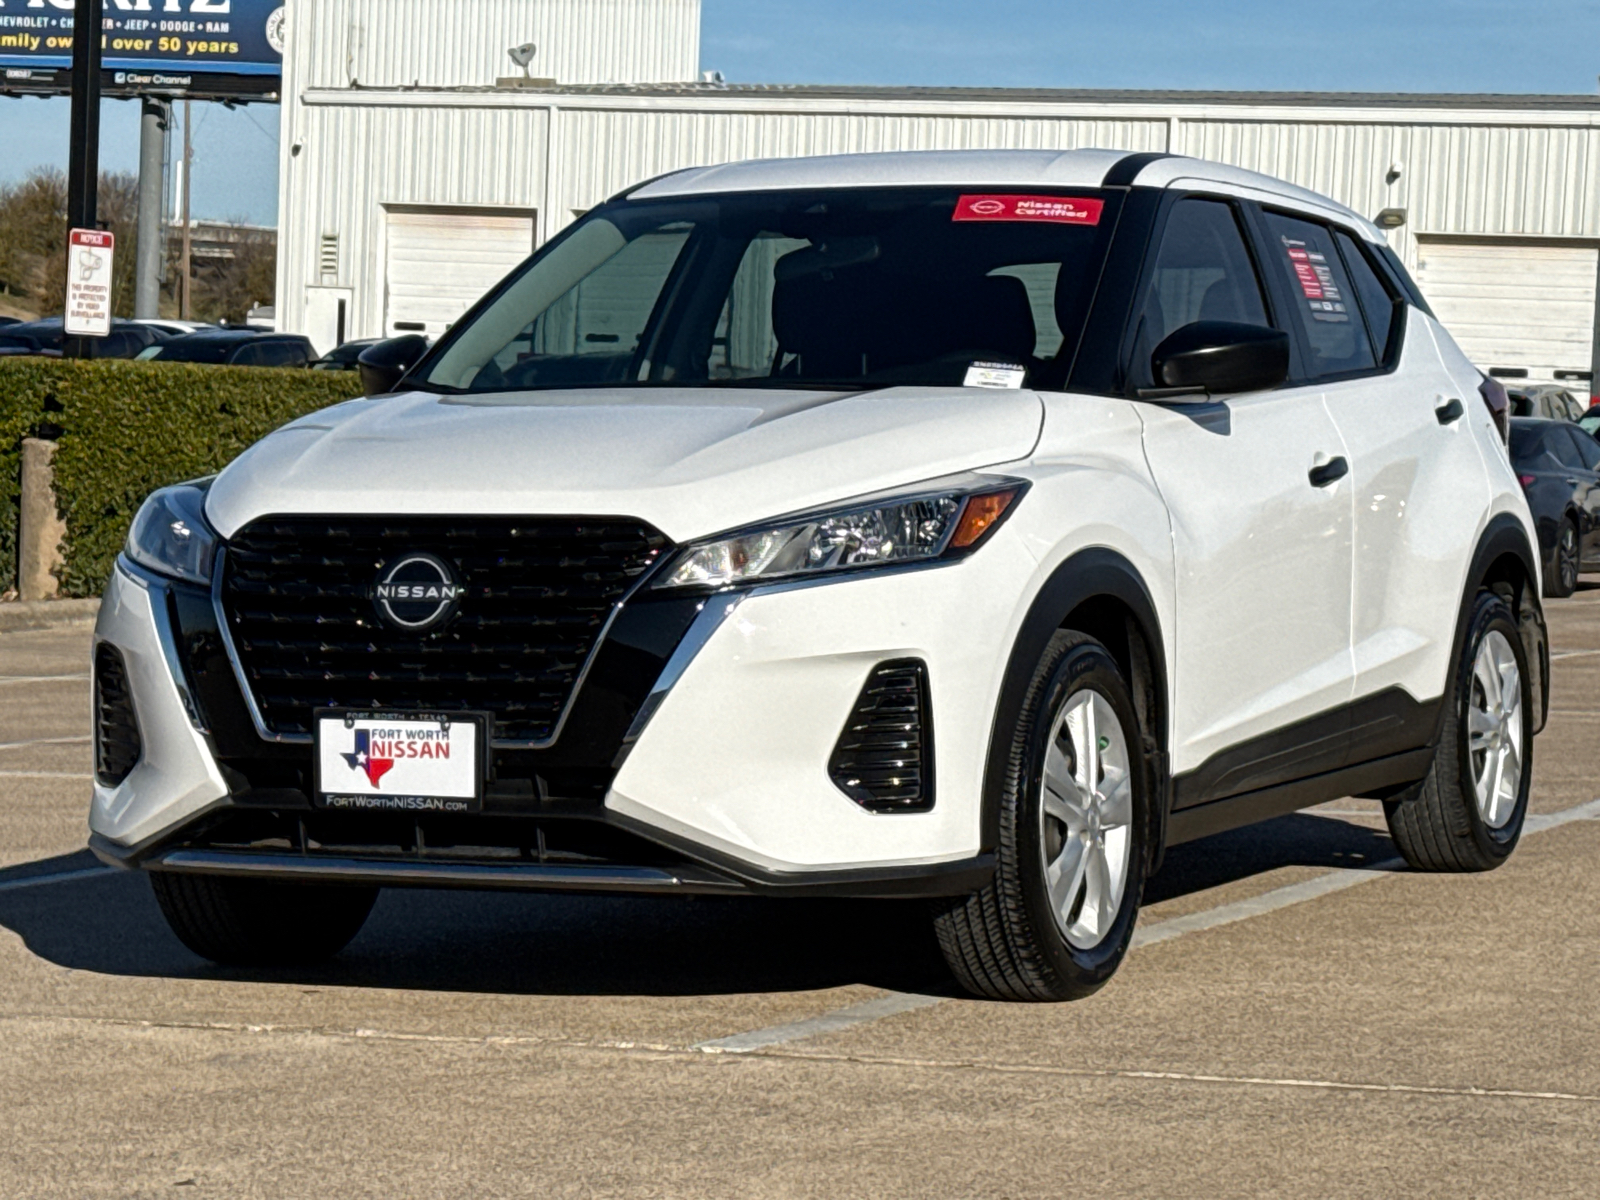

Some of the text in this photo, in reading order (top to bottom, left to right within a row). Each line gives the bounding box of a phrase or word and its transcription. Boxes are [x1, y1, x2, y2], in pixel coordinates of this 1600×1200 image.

[124, 19, 150, 31] JEEP
[160, 20, 195, 32] DODGE
[205, 22, 230, 33] RAM
[112, 38, 153, 51] over
[158, 37, 181, 52] 50
[186, 40, 239, 55] years
[127, 74, 192, 85] Clear Channel
[1017, 201, 1074, 210] Nissan
[1014, 208, 1088, 218] Certified
[377, 585, 456, 598] NISSAN
[346, 712, 370, 720] FORT
[419, 713, 448, 721] TEXAS
[371, 728, 450, 741] FORT WORTH
[371, 740, 450, 759] NISSAN
